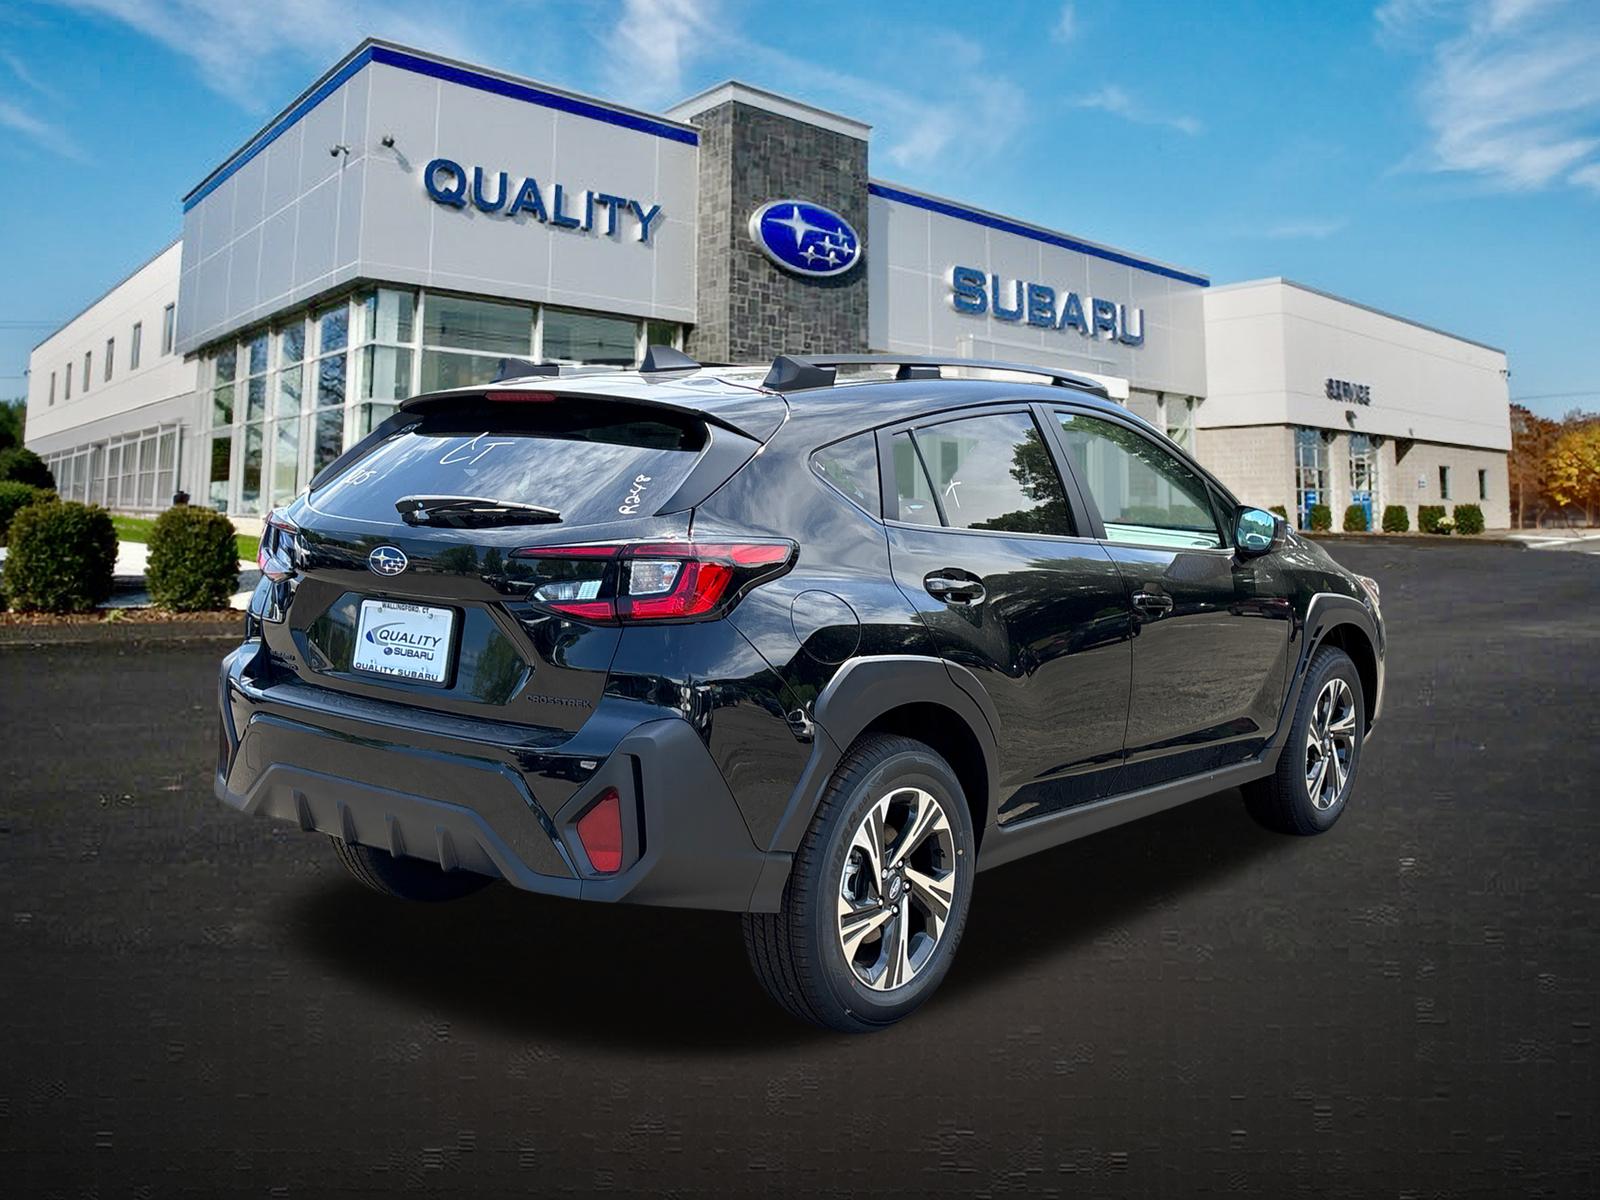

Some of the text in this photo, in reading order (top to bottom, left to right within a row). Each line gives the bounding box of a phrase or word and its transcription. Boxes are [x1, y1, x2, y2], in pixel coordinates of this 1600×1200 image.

[424, 158, 661, 242] QUALITY
[949, 265, 1144, 346] SUBARU
[379, 629, 442, 648] QUALITY
[393, 647, 434, 661] SUBARU
[355, 662, 438, 681] QUALITY SUBARU
